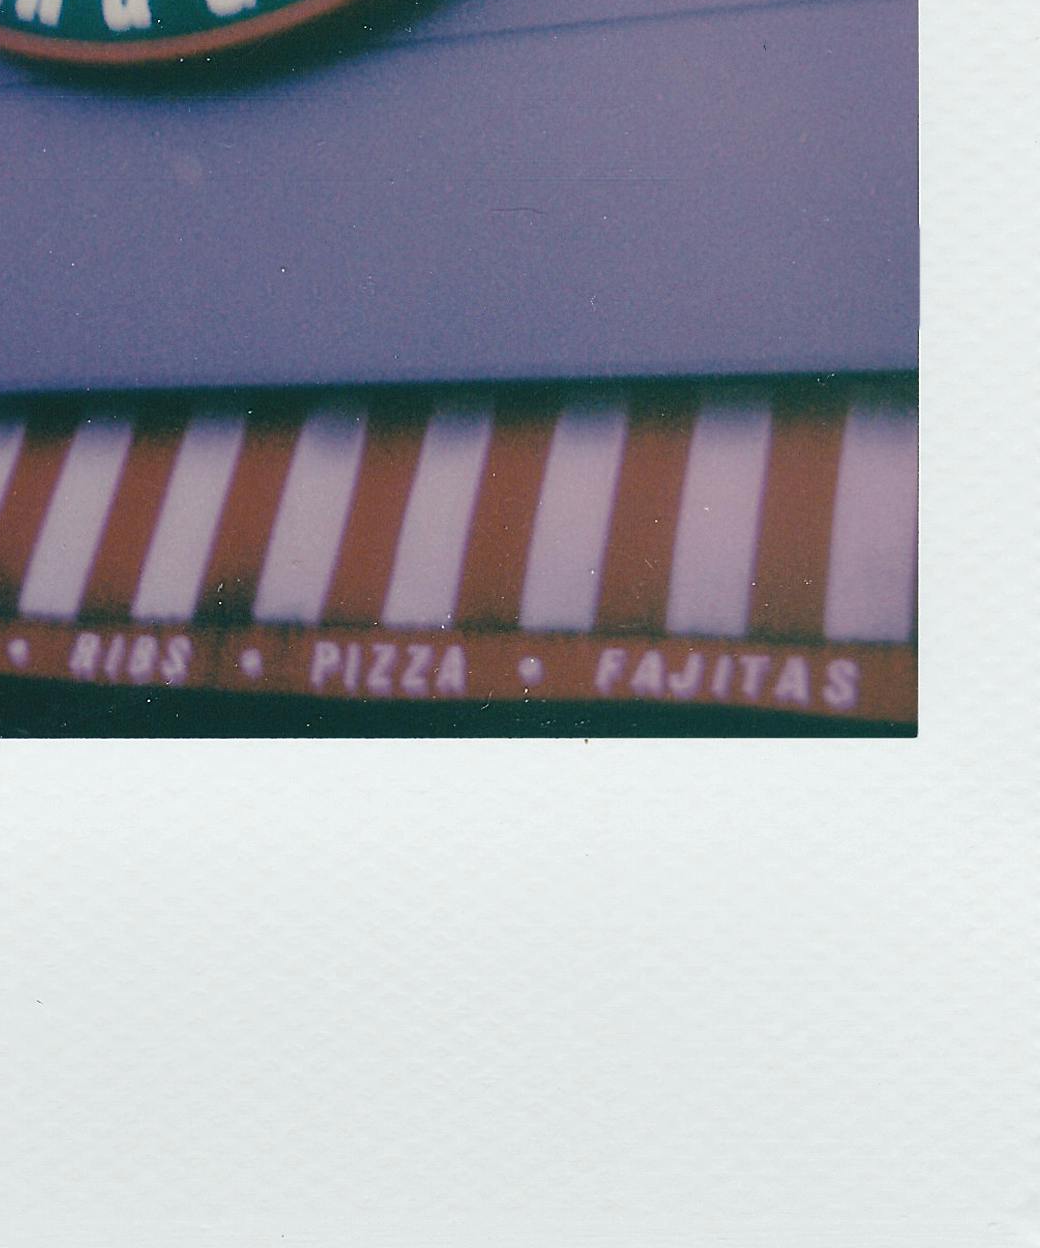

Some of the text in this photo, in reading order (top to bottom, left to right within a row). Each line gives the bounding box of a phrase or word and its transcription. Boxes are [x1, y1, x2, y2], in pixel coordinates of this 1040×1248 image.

[69, 633, 194, 684] RIBS
[310, 642, 467, 694] PIZZA
[595, 648, 861, 708] FAJITAS
